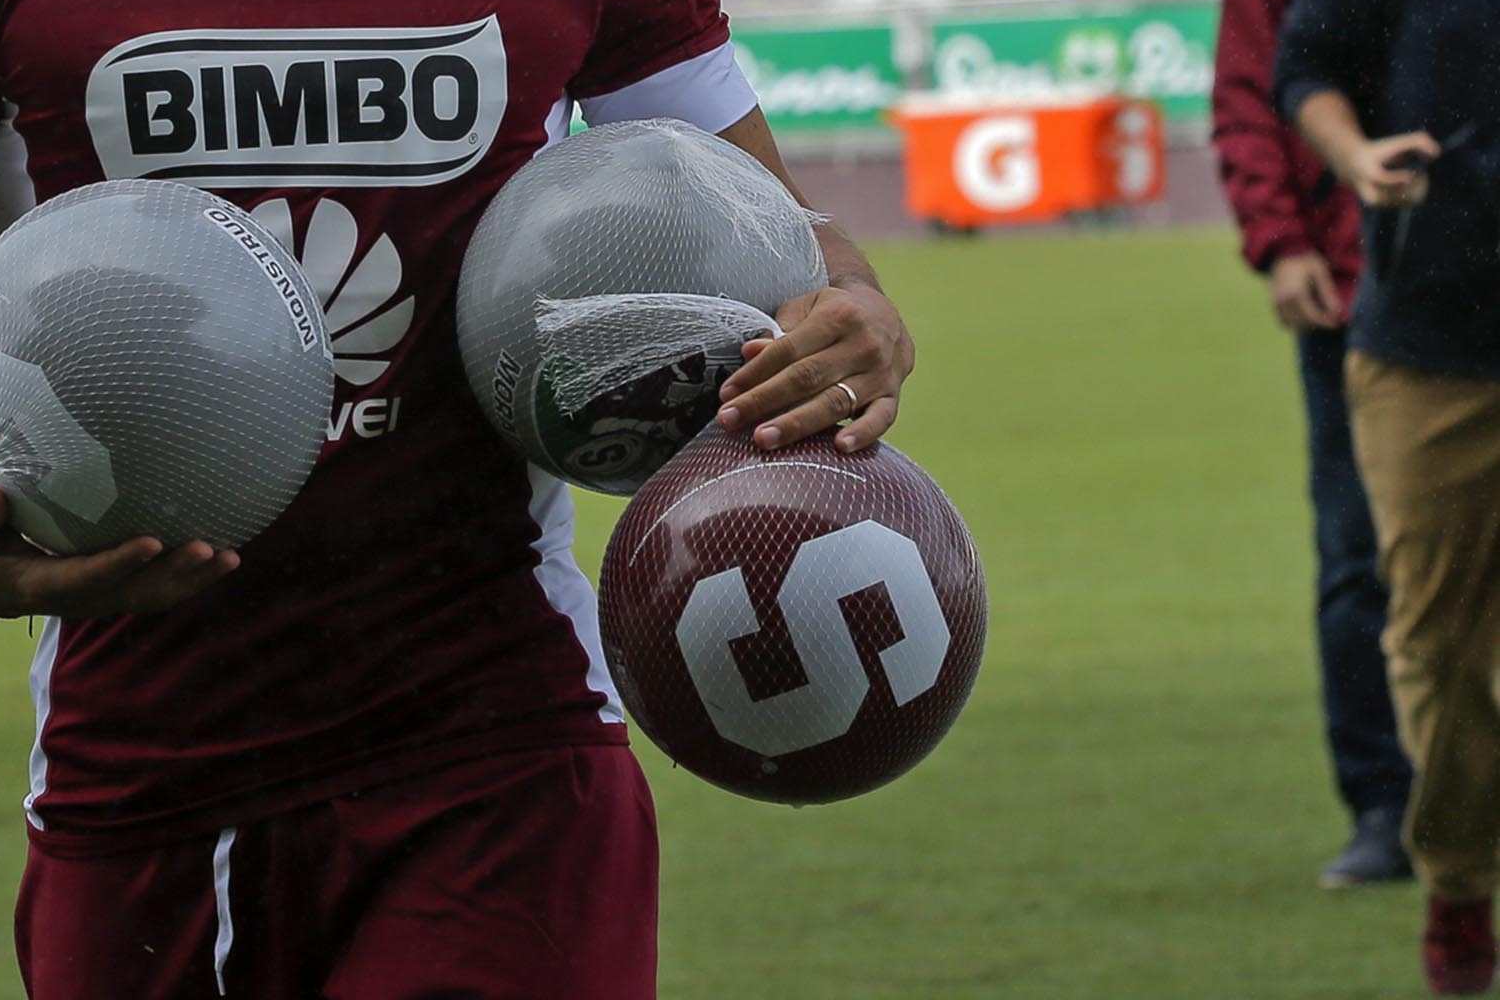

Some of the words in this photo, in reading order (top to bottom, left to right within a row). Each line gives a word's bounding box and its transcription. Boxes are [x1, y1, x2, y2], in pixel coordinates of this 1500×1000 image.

[122, 54, 479, 156] BIMBO
[953, 116, 1043, 212] G
[208, 210, 317, 346] MONSTRUO
[675, 519, 951, 757] S
